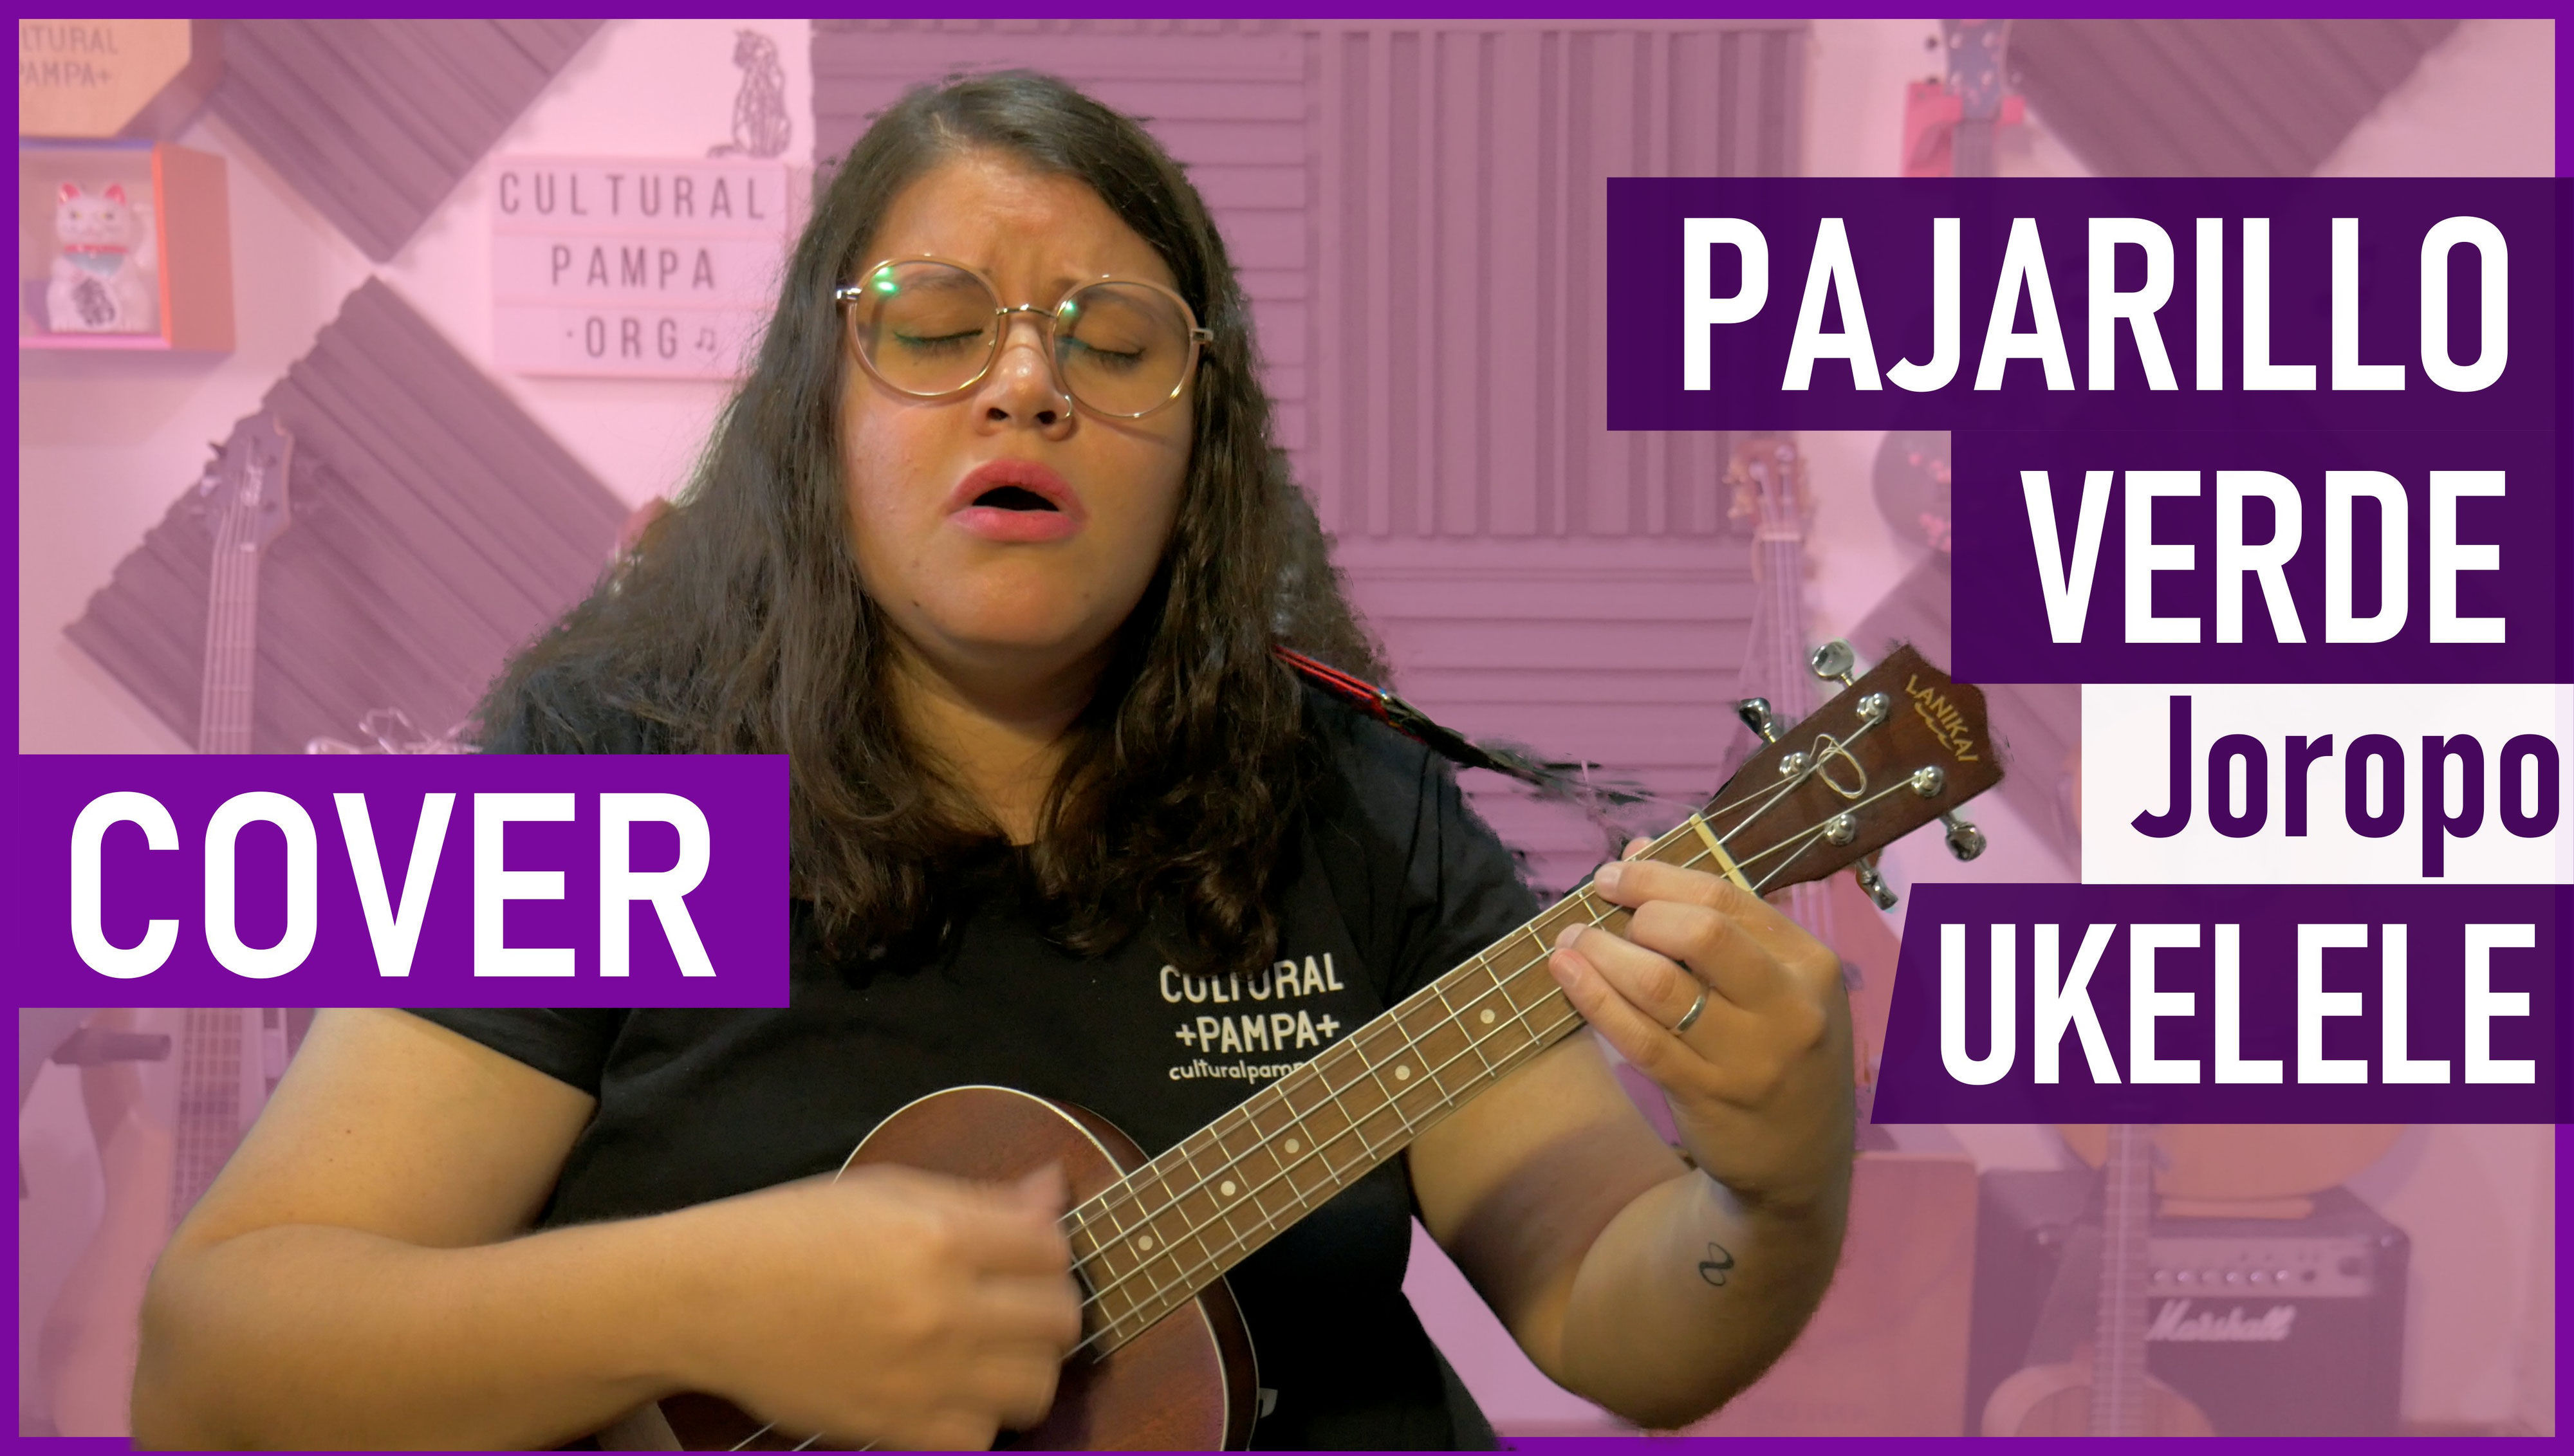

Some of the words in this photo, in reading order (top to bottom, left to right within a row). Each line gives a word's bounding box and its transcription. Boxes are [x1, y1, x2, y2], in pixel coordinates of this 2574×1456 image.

[499, 171, 765, 220] CULTURAL
[551, 244, 715, 290] PAMPA
[1905, 674, 1979, 762] LANIKAI
[1175, 1009, 1340, 1053] +PAMPA+
